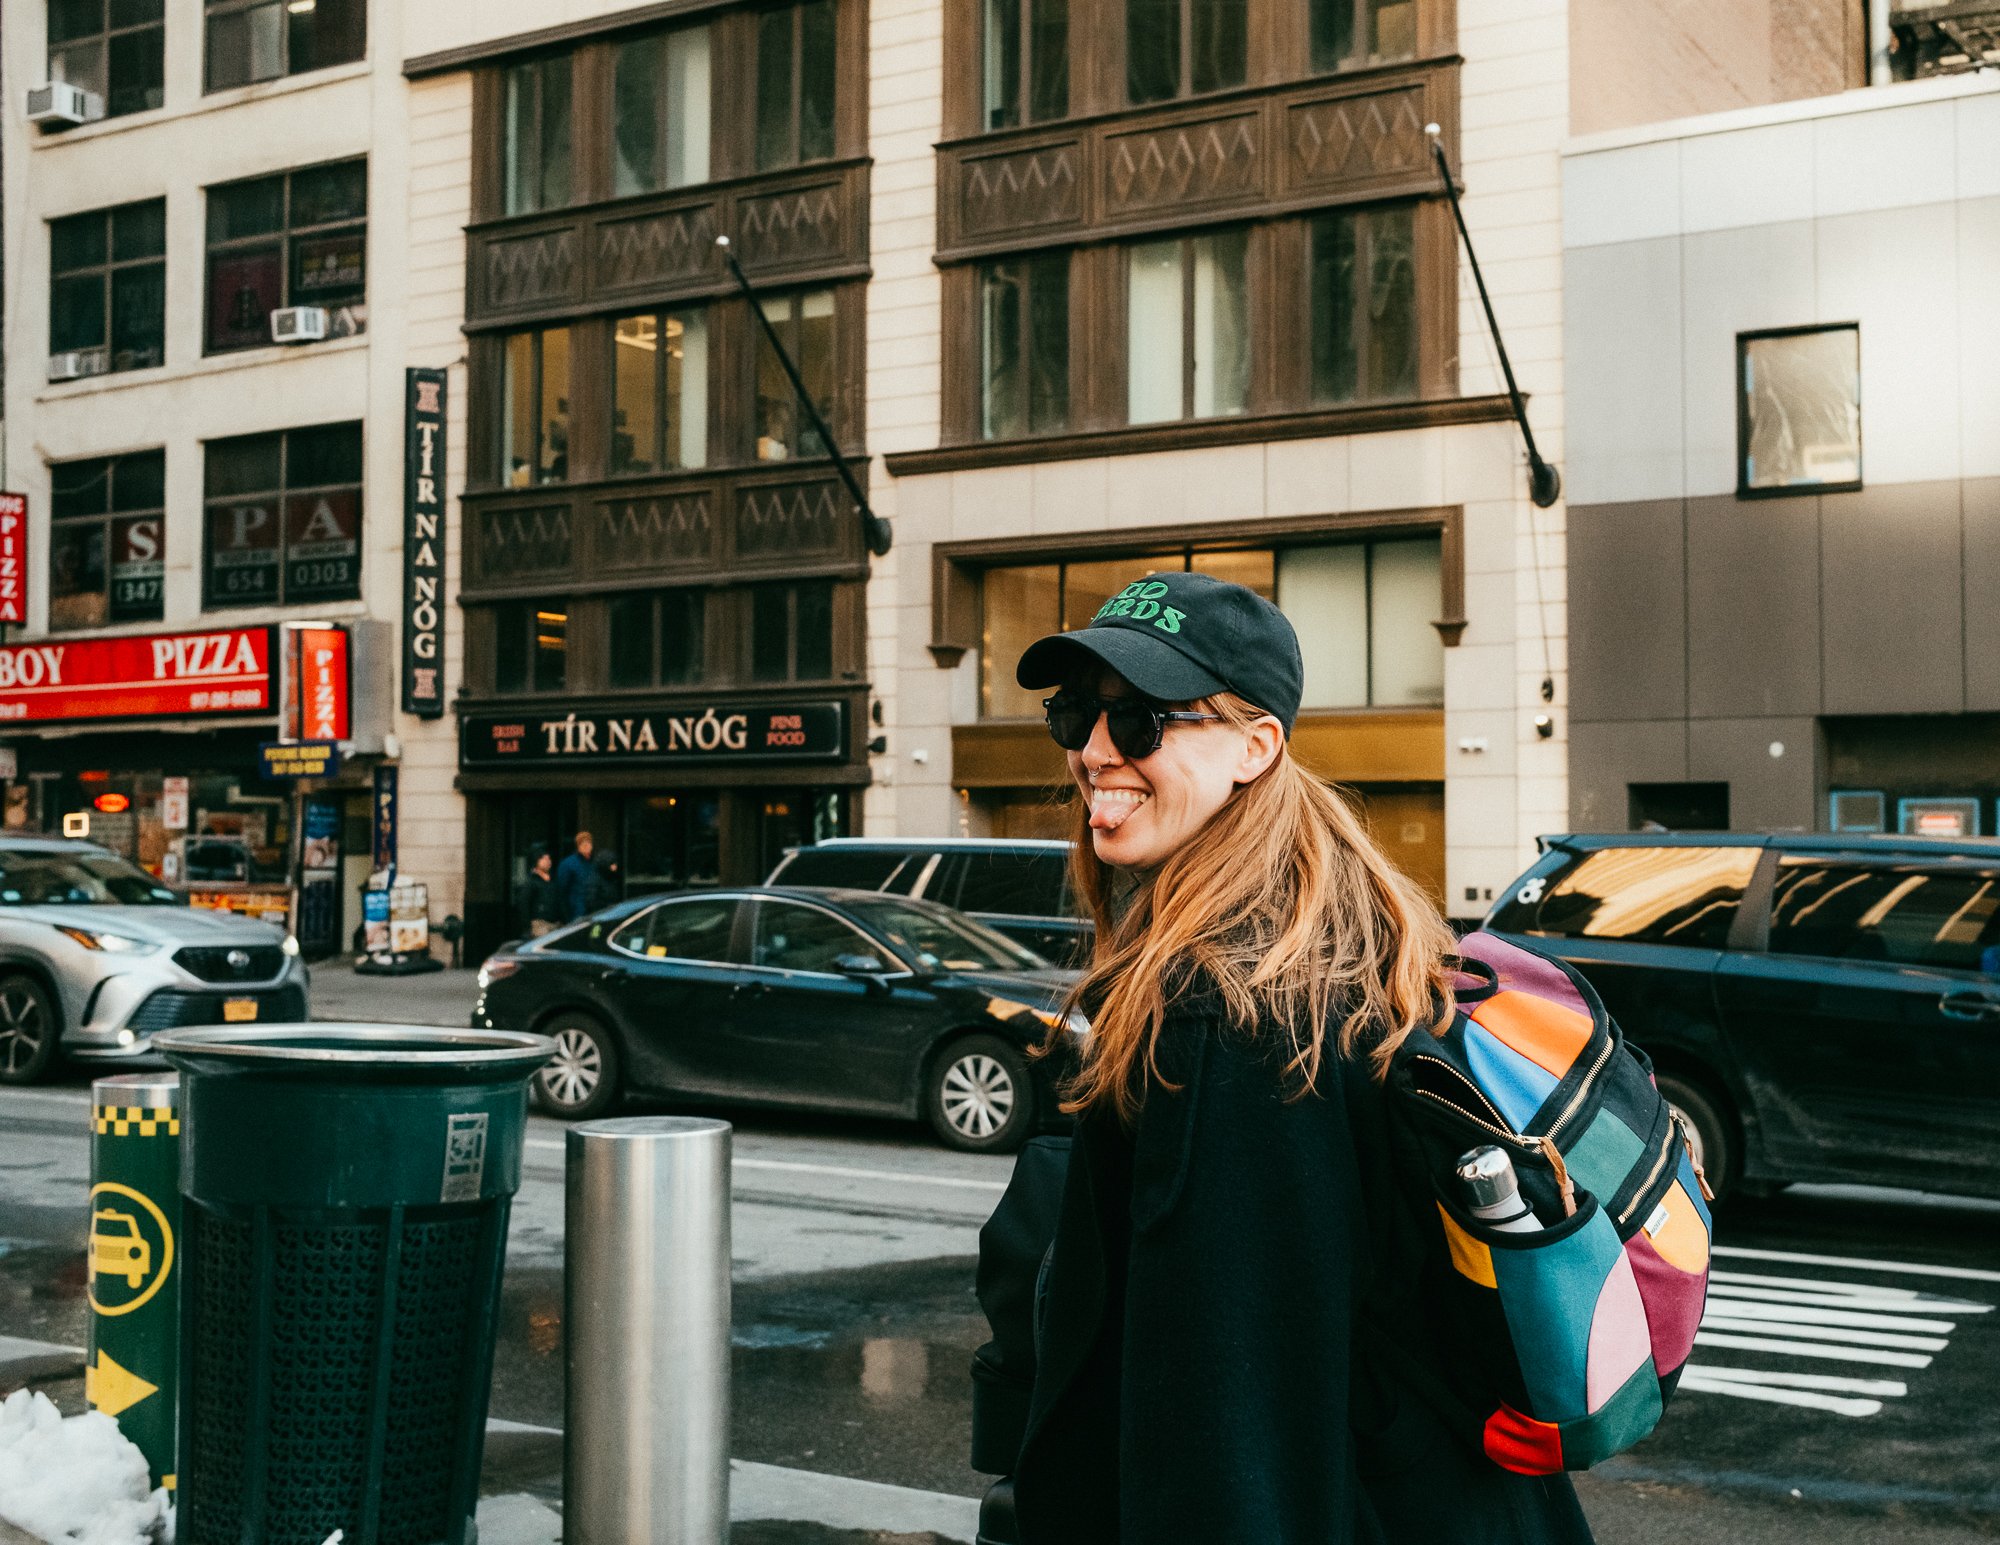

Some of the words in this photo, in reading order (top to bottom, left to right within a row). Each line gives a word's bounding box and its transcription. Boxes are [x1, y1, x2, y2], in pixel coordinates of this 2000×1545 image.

[414, 513, 438, 567] NA
[0, 515, 18, 620] PIZZA
[296, 562, 349, 585] 0303
[151, 633, 259, 679] PIZZA
[315, 649, 335, 738] PIZZA
[541, 713, 599, 753] TÍR
[607, 719, 659, 752] NA
[668, 707, 747, 751] NÓG
[766, 731, 805, 746] FOOD
